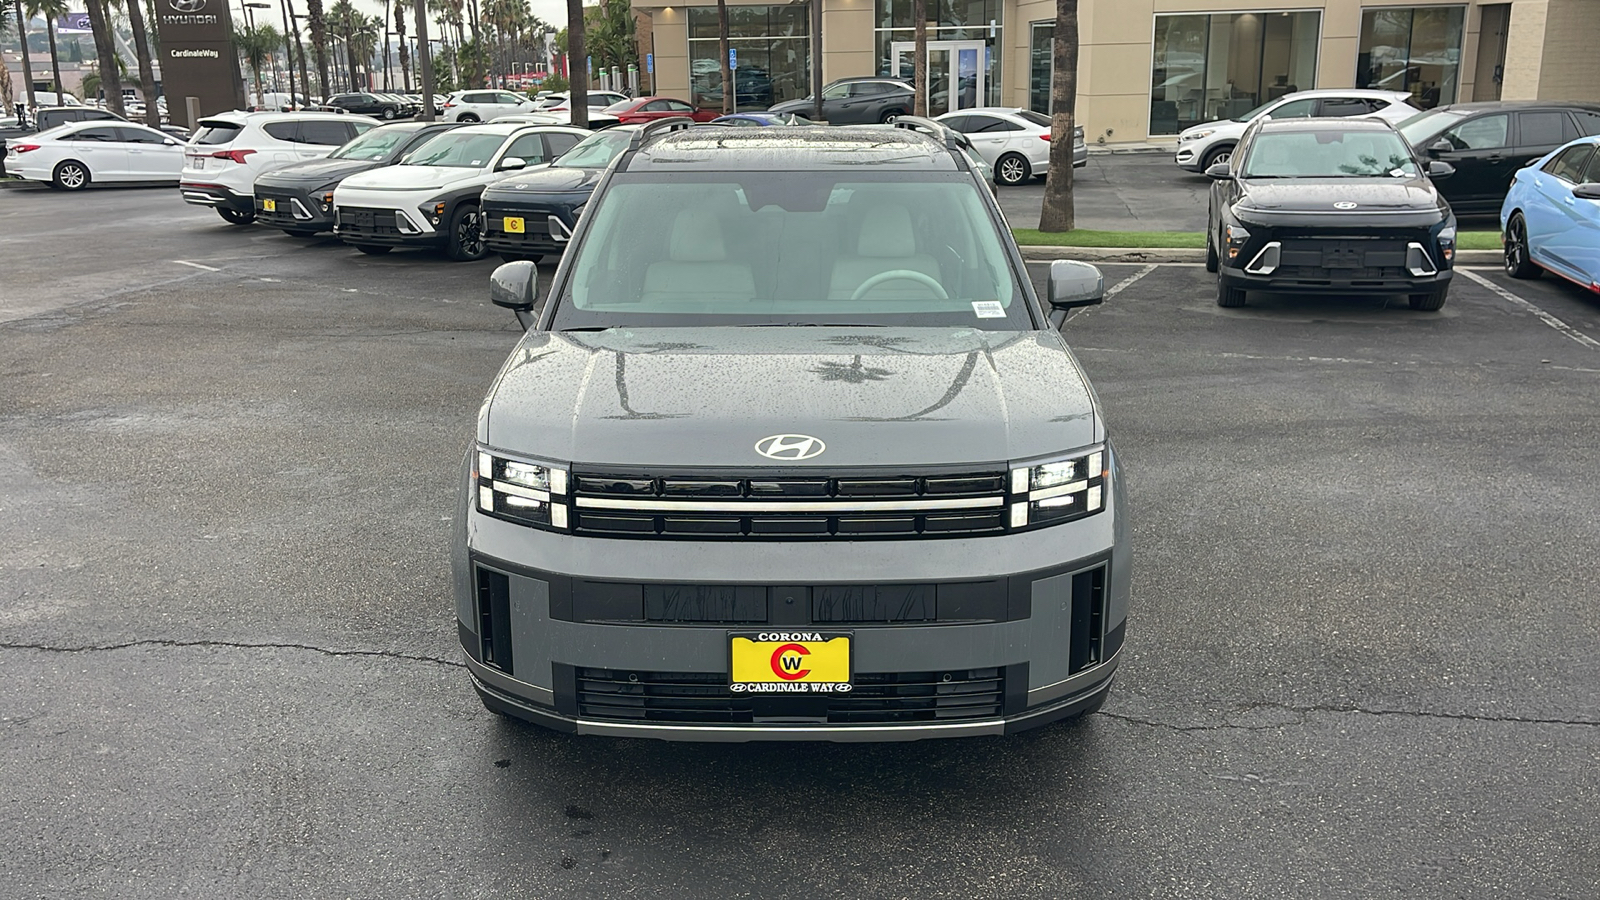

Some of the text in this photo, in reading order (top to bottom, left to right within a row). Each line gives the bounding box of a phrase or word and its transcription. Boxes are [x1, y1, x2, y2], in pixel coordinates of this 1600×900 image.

[163, 15, 217, 24] HYUNDAI
[171, 50, 219, 58] CardinaleWay
[758, 632, 823, 641] CORONA
[747, 683, 836, 692] CARDINALE WAY
